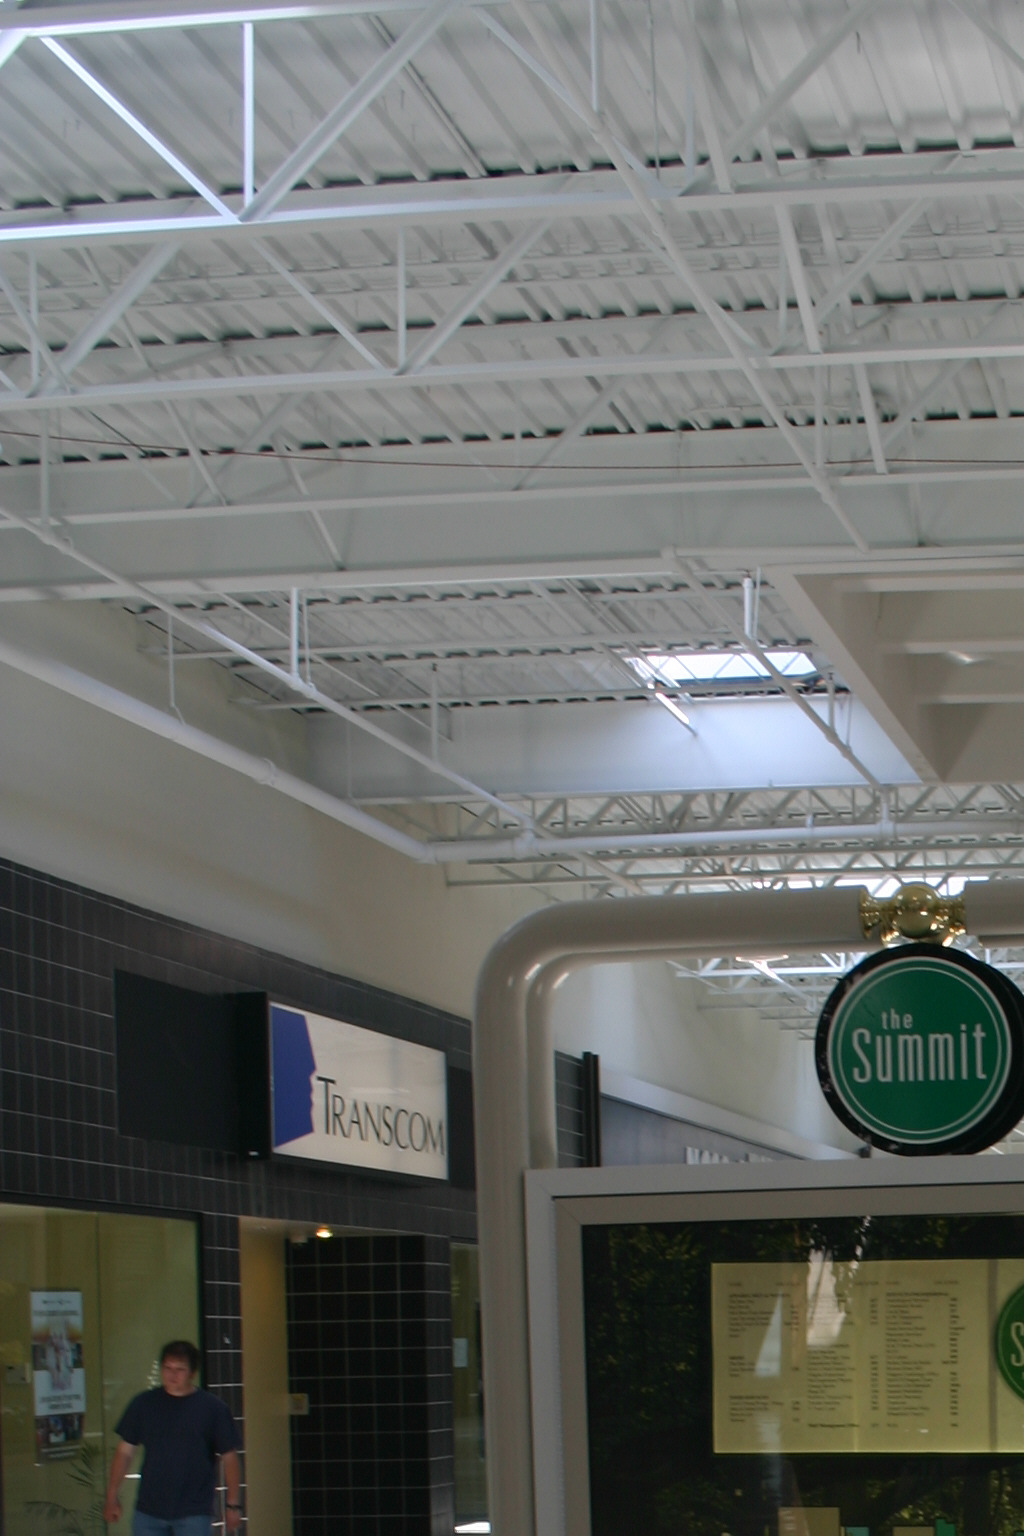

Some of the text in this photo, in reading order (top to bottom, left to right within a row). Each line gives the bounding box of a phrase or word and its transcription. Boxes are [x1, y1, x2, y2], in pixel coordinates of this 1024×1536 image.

[881, 1008, 913, 1030] the
[852, 1023, 987, 1083] Summit
[315, 1076, 446, 1156] TRANSCOM
